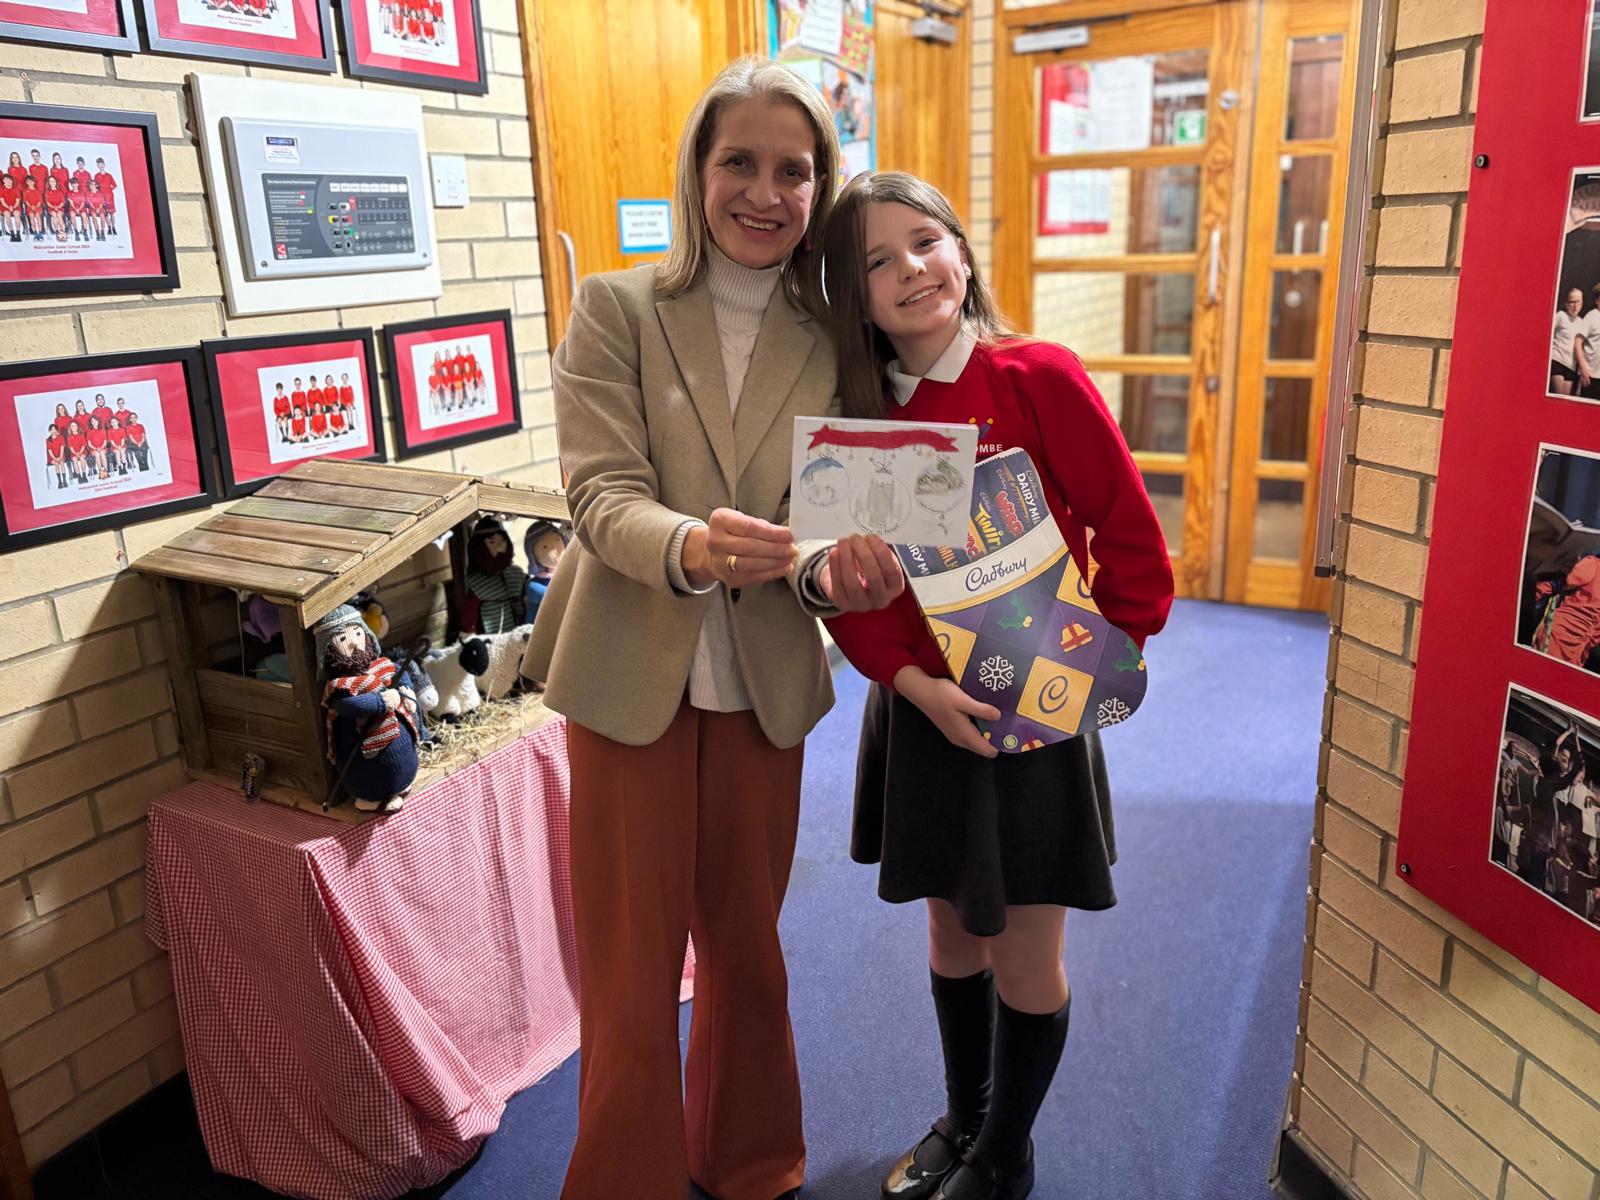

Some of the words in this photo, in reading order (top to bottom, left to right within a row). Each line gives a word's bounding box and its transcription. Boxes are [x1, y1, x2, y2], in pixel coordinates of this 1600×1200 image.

[976, 443, 1004, 453] MBE
[1016, 472, 1036, 506] DAIRY
[965, 558, 1028, 592] Cadbury
